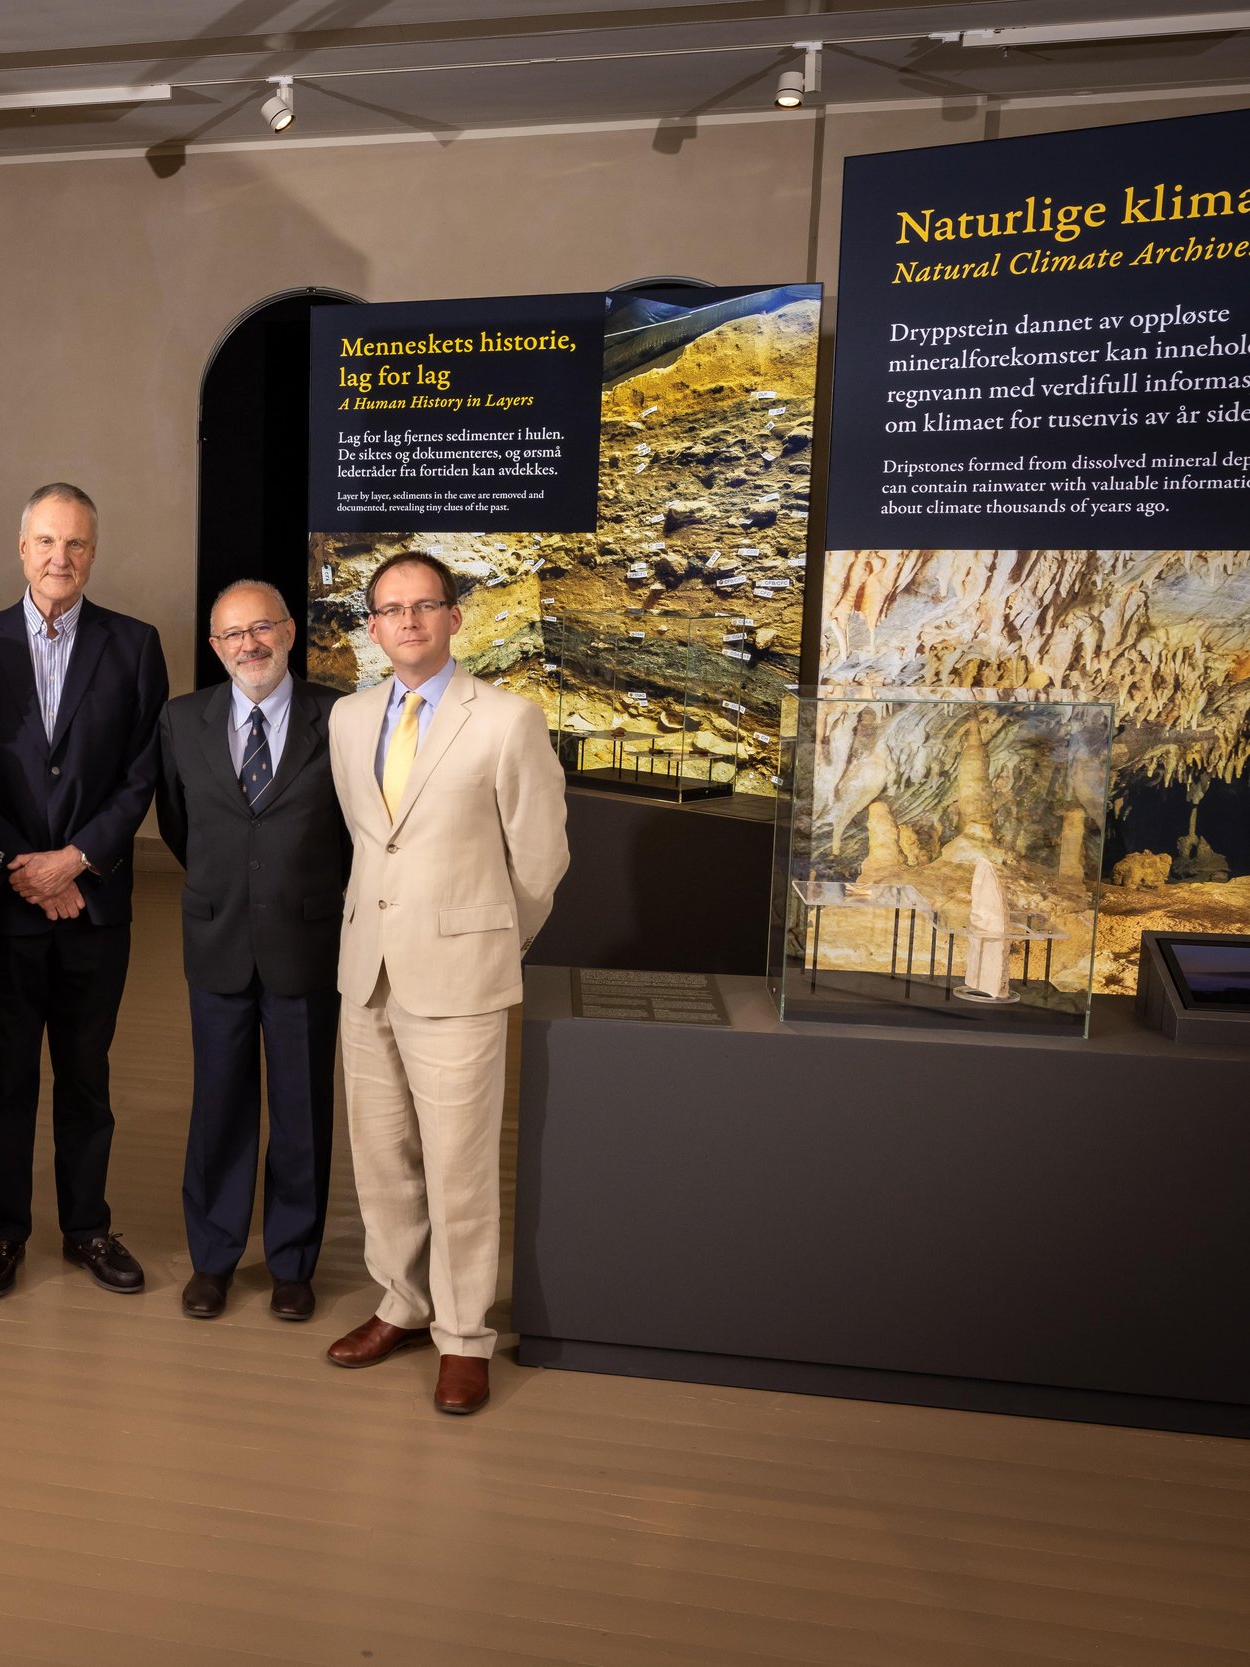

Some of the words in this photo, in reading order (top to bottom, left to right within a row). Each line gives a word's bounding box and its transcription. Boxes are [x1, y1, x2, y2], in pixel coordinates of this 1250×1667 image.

[895, 196, 1106, 244] Naturlige
[891, 253, 1001, 284] Natural
[1009, 249, 1123, 275] Climate
[1129, 236, 1250, 266] Archive
[889, 318, 1009, 347] Dryppstein
[1015, 314, 1093, 334] dannet
[1099, 316, 1124, 329] av
[1130, 304, 1230, 334] oppløste
[340, 333, 473, 357] Menneskets
[479, 330, 576, 352] historie,
[888, 346, 1100, 373] mineralforekomster
[1105, 341, 1148, 362] kan
[1155, 333, 1250, 359] innehol
[339, 366, 372, 393] lag
[378, 365, 411, 386] for
[416, 364, 451, 391] lag
[887, 387, 982, 409] regnvann
[988, 377, 1035, 399] med
[1041, 372, 1138, 397] verdifull
[338, 398, 349, 410] A
[353, 397, 406, 410] Human
[410, 396, 463, 412] History
[467, 394, 481, 407] in
[485, 394, 534, 410] Layers
[885, 420, 917, 433] om
[922, 412, 1004, 432] klimaet
[1010, 409, 1042, 429] for
[1048, 408, 1138, 428] tusenvis
[1145, 412, 1170, 425] av
[1176, 405, 1200, 424] år
[338, 431, 361, 447] Lag
[363, 430, 381, 443] for
[383, 430, 402, 447] lag
[404, 429, 443, 446] fjernes
[446, 428, 515, 442] sedimenter
[517, 429, 522, 440] i
[525, 427, 564, 440] hulen.
[338, 448, 356, 461] De
[358, 447, 392, 460] siktes
[395, 451, 410, 464] og
[412, 446, 502, 460] dokumenteres,
[505, 449, 521, 462] og
[523, 445, 562, 458] ørsmå
[882, 460, 964, 477] Dripstones
[968, 456, 1024, 472] formed
[1028, 455, 1067, 470] from
[1072, 453, 1146, 469] dissolved
[1151, 451, 1217, 468] mineral
[337, 464, 397, 478] ledetråder
[400, 464, 417, 477] fra
[419, 463, 469, 477] fortiden
[472, 463, 495, 476] kan
[498, 462, 558, 476] avdekkes.
[337, 492, 359, 502] Layer
[360, 491, 370, 502] by
[371, 491, 391, 502] layer,
[393, 491, 432, 500] sediments
[434, 491, 442, 499] in
[444, 490, 458, 499] the
[492, 490, 527, 499] removed
[528, 490, 544, 499] and
[881, 484, 907, 494] can
[911, 480, 968, 493] contain
[972, 479, 1047, 493] rainwater
[1050, 476, 1087, 491] with
[1091, 475, 1159, 491] valuable
[336, 503, 387, 512] documented,
[389, 502, 425, 514] revealing
[426, 503, 442, 514] tiny
[443, 502, 463, 511] clues
[465, 502, 475, 511] of
[475, 502, 489, 511] the
[490, 505, 509, 513] past.
[881, 500, 923, 515] about
[926, 499, 982, 514] climate
[986, 498, 1066, 514] thousands
[1070, 497, 1090, 513] of
[1091, 503, 1132, 517] years
[1136, 502, 1169, 517] ago.
